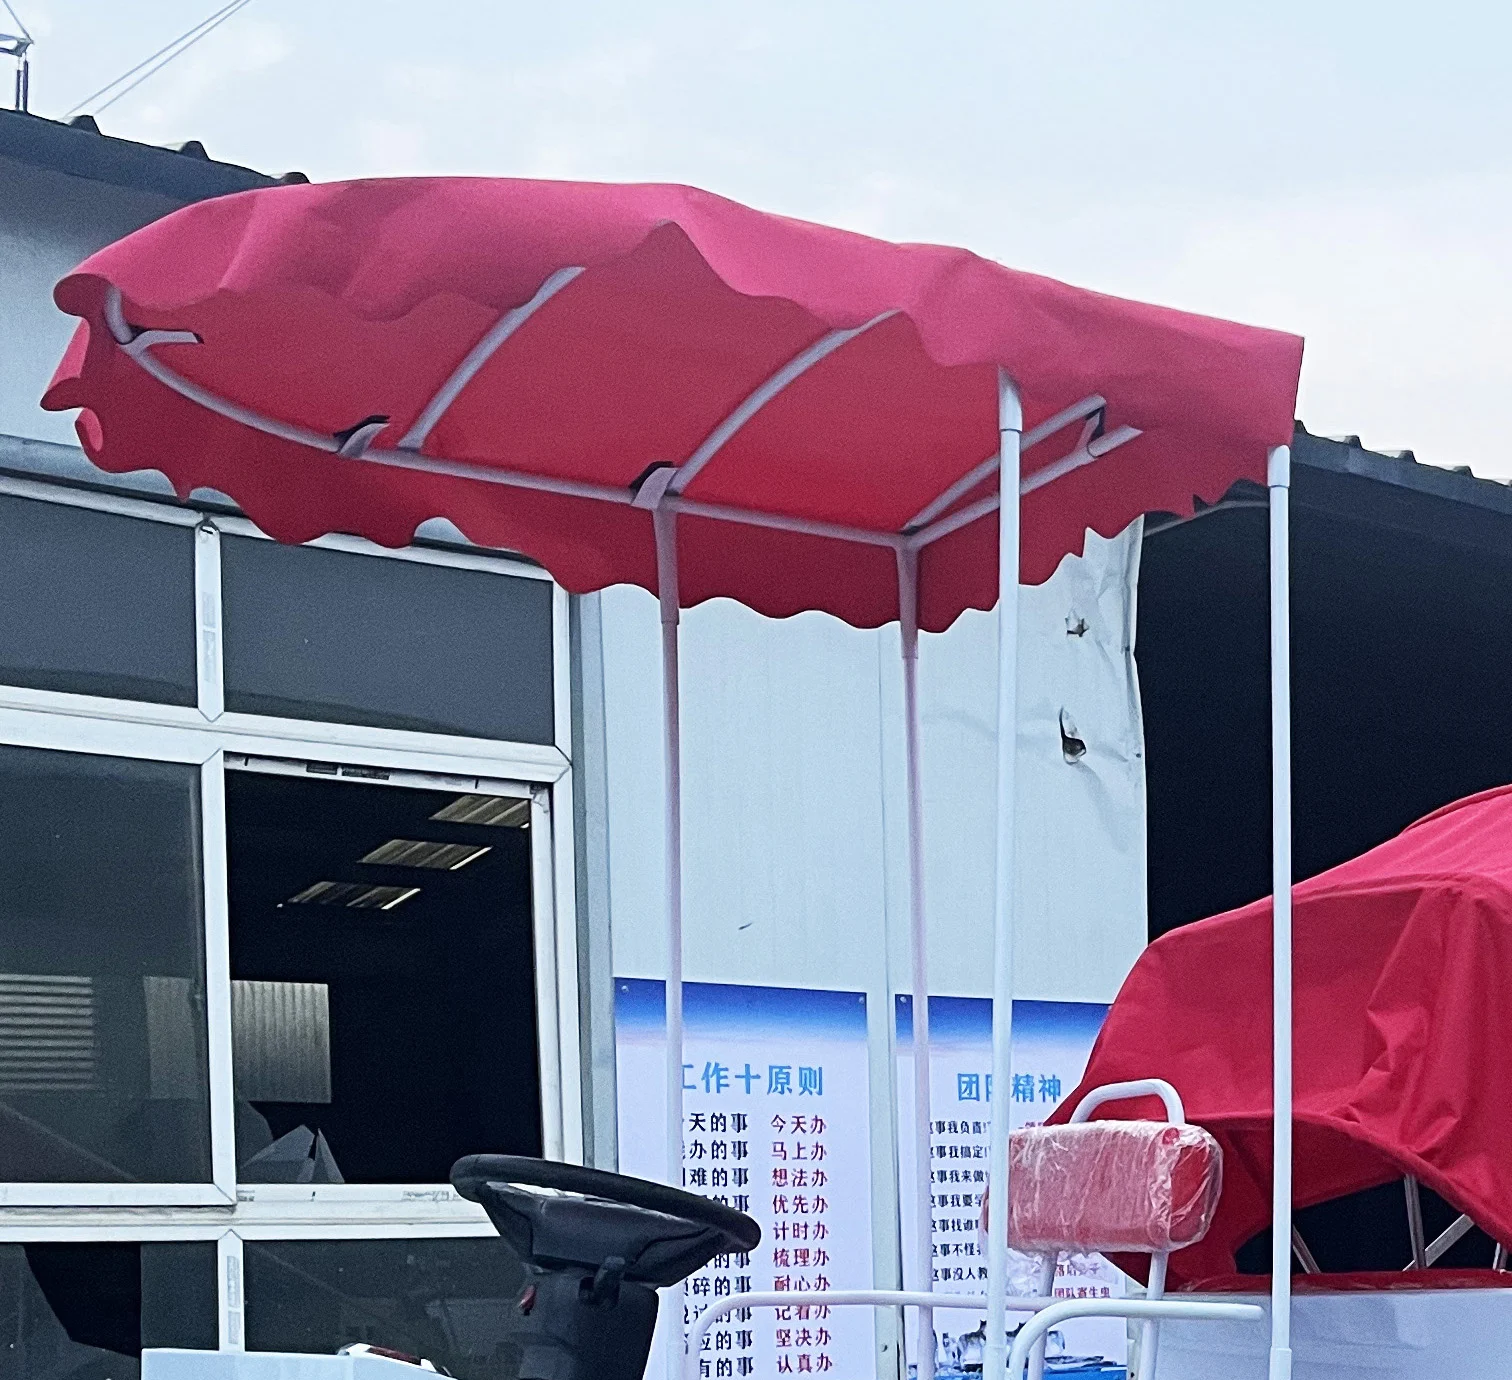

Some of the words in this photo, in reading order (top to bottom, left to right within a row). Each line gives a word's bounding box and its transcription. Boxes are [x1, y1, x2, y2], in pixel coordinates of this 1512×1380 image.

[682, 1061, 823, 1096] 工作十原则
[682, 1112, 748, 1133] 天的事
[771, 1114, 827, 1134] 今天办
[682, 1139, 749, 1160] 办的事
[771, 1140, 827, 1160] 马上办
[682, 1167, 749, 1187] 难的事
[771, 1167, 828, 1187] 想法办
[772, 1194, 828, 1214] 优先办
[773, 1220, 829, 1240] 计时办
[773, 1247, 829, 1267] 梳理办
[774, 1273, 830, 1291] 耐心办
[684, 1329, 752, 1355] 应的事
[776, 1326, 832, 1347] 坚决办
[777, 1352, 833, 1373] 认真办
